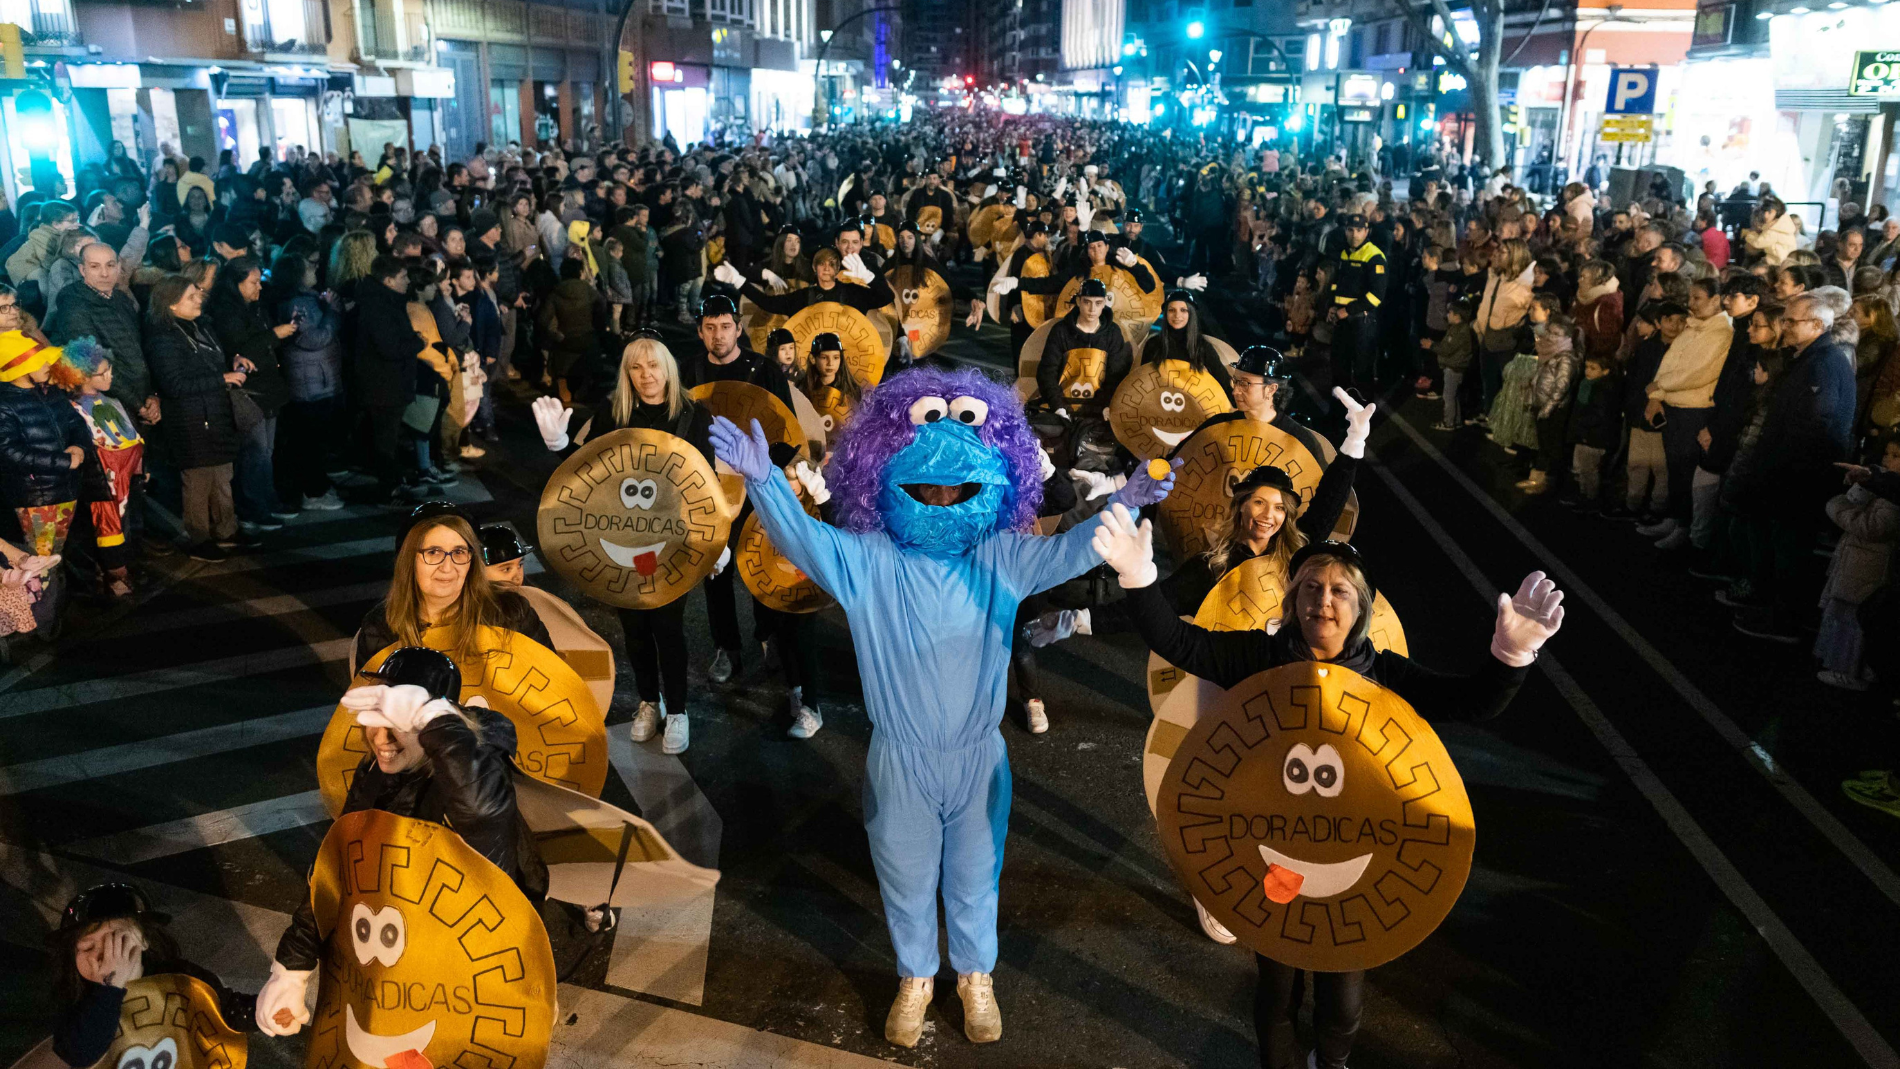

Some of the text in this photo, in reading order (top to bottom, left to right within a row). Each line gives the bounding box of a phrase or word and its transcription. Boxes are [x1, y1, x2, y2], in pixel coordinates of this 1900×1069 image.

[1614, 72, 1649, 111] P
[584, 513, 686, 536] DORADICAS
[1229, 814, 1398, 846] DORADICAS
